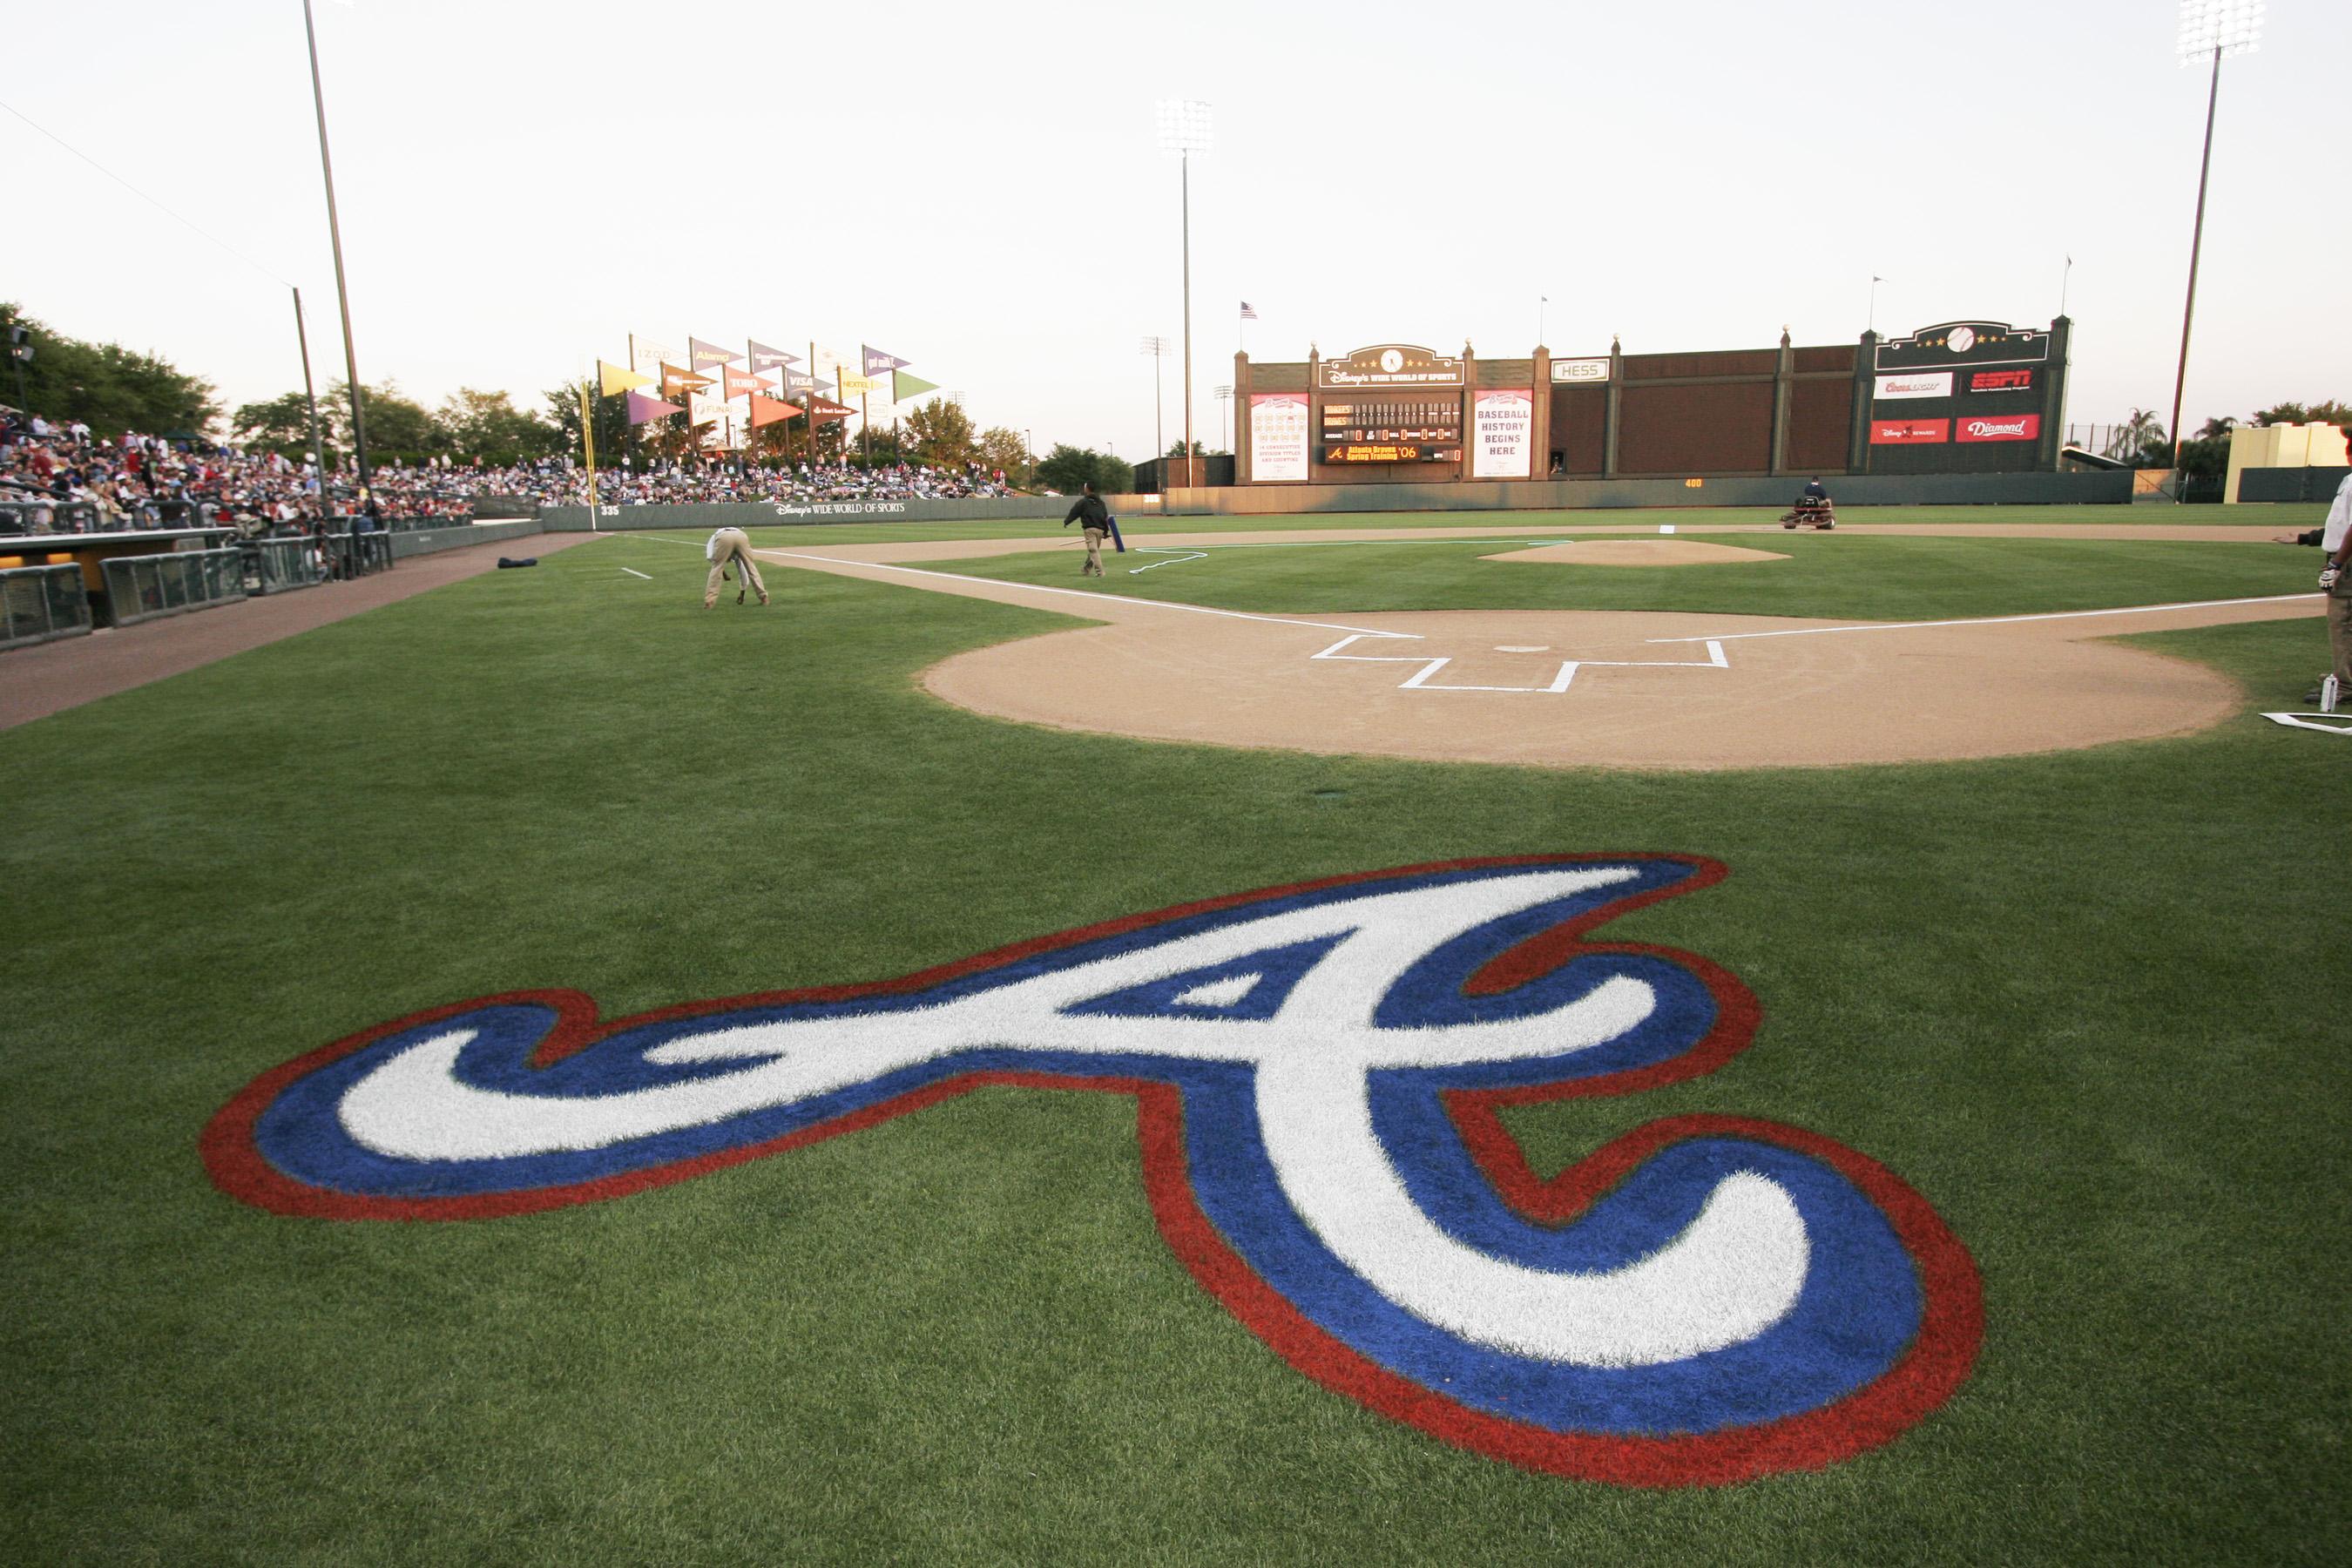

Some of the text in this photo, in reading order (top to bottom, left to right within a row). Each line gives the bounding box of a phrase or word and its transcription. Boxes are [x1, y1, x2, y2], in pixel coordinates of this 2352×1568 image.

[696, 351, 729, 362] Alamo
[1562, 364, 1598, 377] HESS
[730, 378, 758, 388] TORO
[788, 376, 814, 386] VISA
[1328, 370, 1369, 386] Disney's
[1971, 369, 2031, 389] ESPN
[1885, 382, 1909, 392] Coors
[1968, 420, 2026, 436] Diamond
[1398, 446, 1416, 458] '06
[1686, 478, 1702, 488] 400
[601, 505, 619, 516] 335
[774, 503, 905, 517] Disney's WIDE WORLD OF SPORTS
